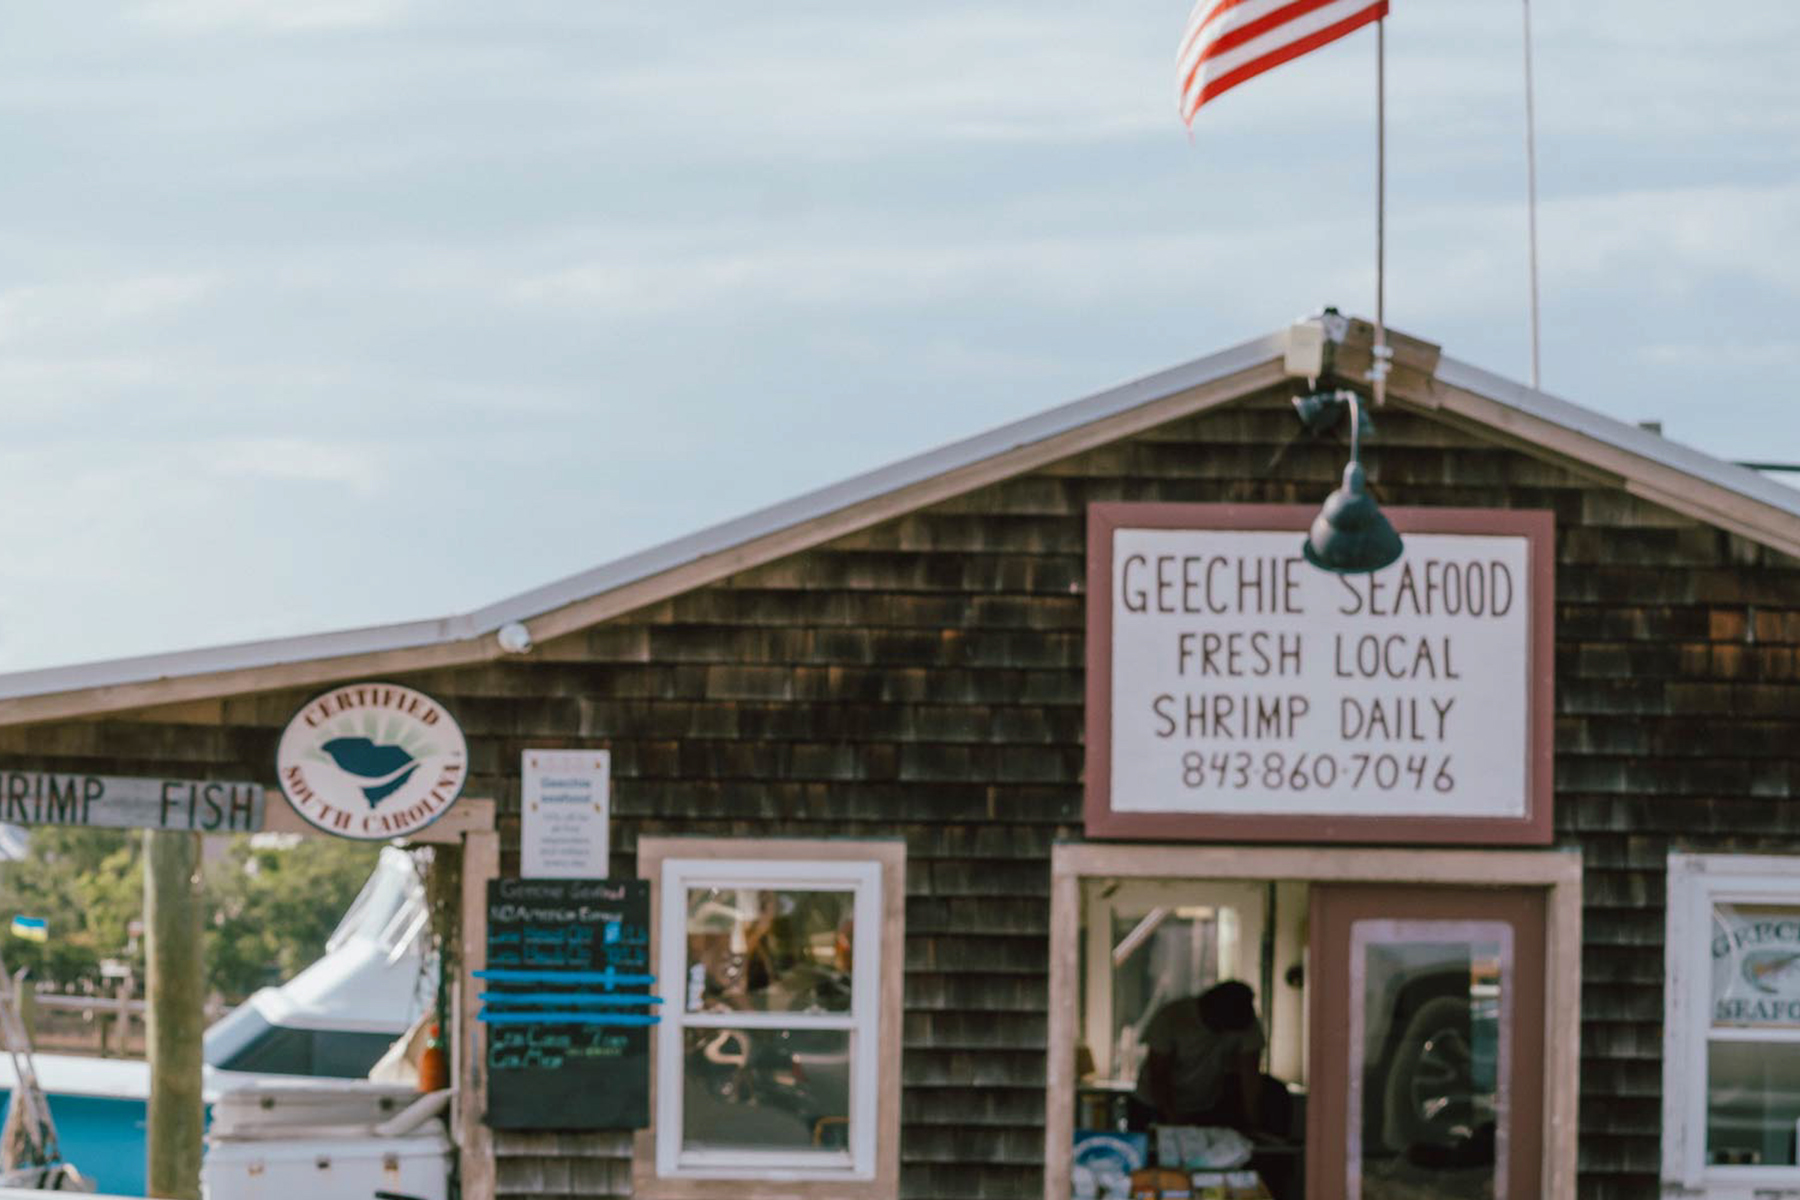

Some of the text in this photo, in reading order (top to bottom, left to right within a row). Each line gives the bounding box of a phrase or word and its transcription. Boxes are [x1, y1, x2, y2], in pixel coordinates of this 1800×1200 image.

[1121, 554, 1514, 618] GEECHIE SEAFOOD
[1178, 631, 1462, 680] FRESH LOCAL
[304, 688, 440, 729] CERTIFIED
[1151, 693, 1457, 742] SHRIMP DAILY
[159, 779, 256, 832] FISH
[285, 758, 461, 832] SOUTH CAROLINA
